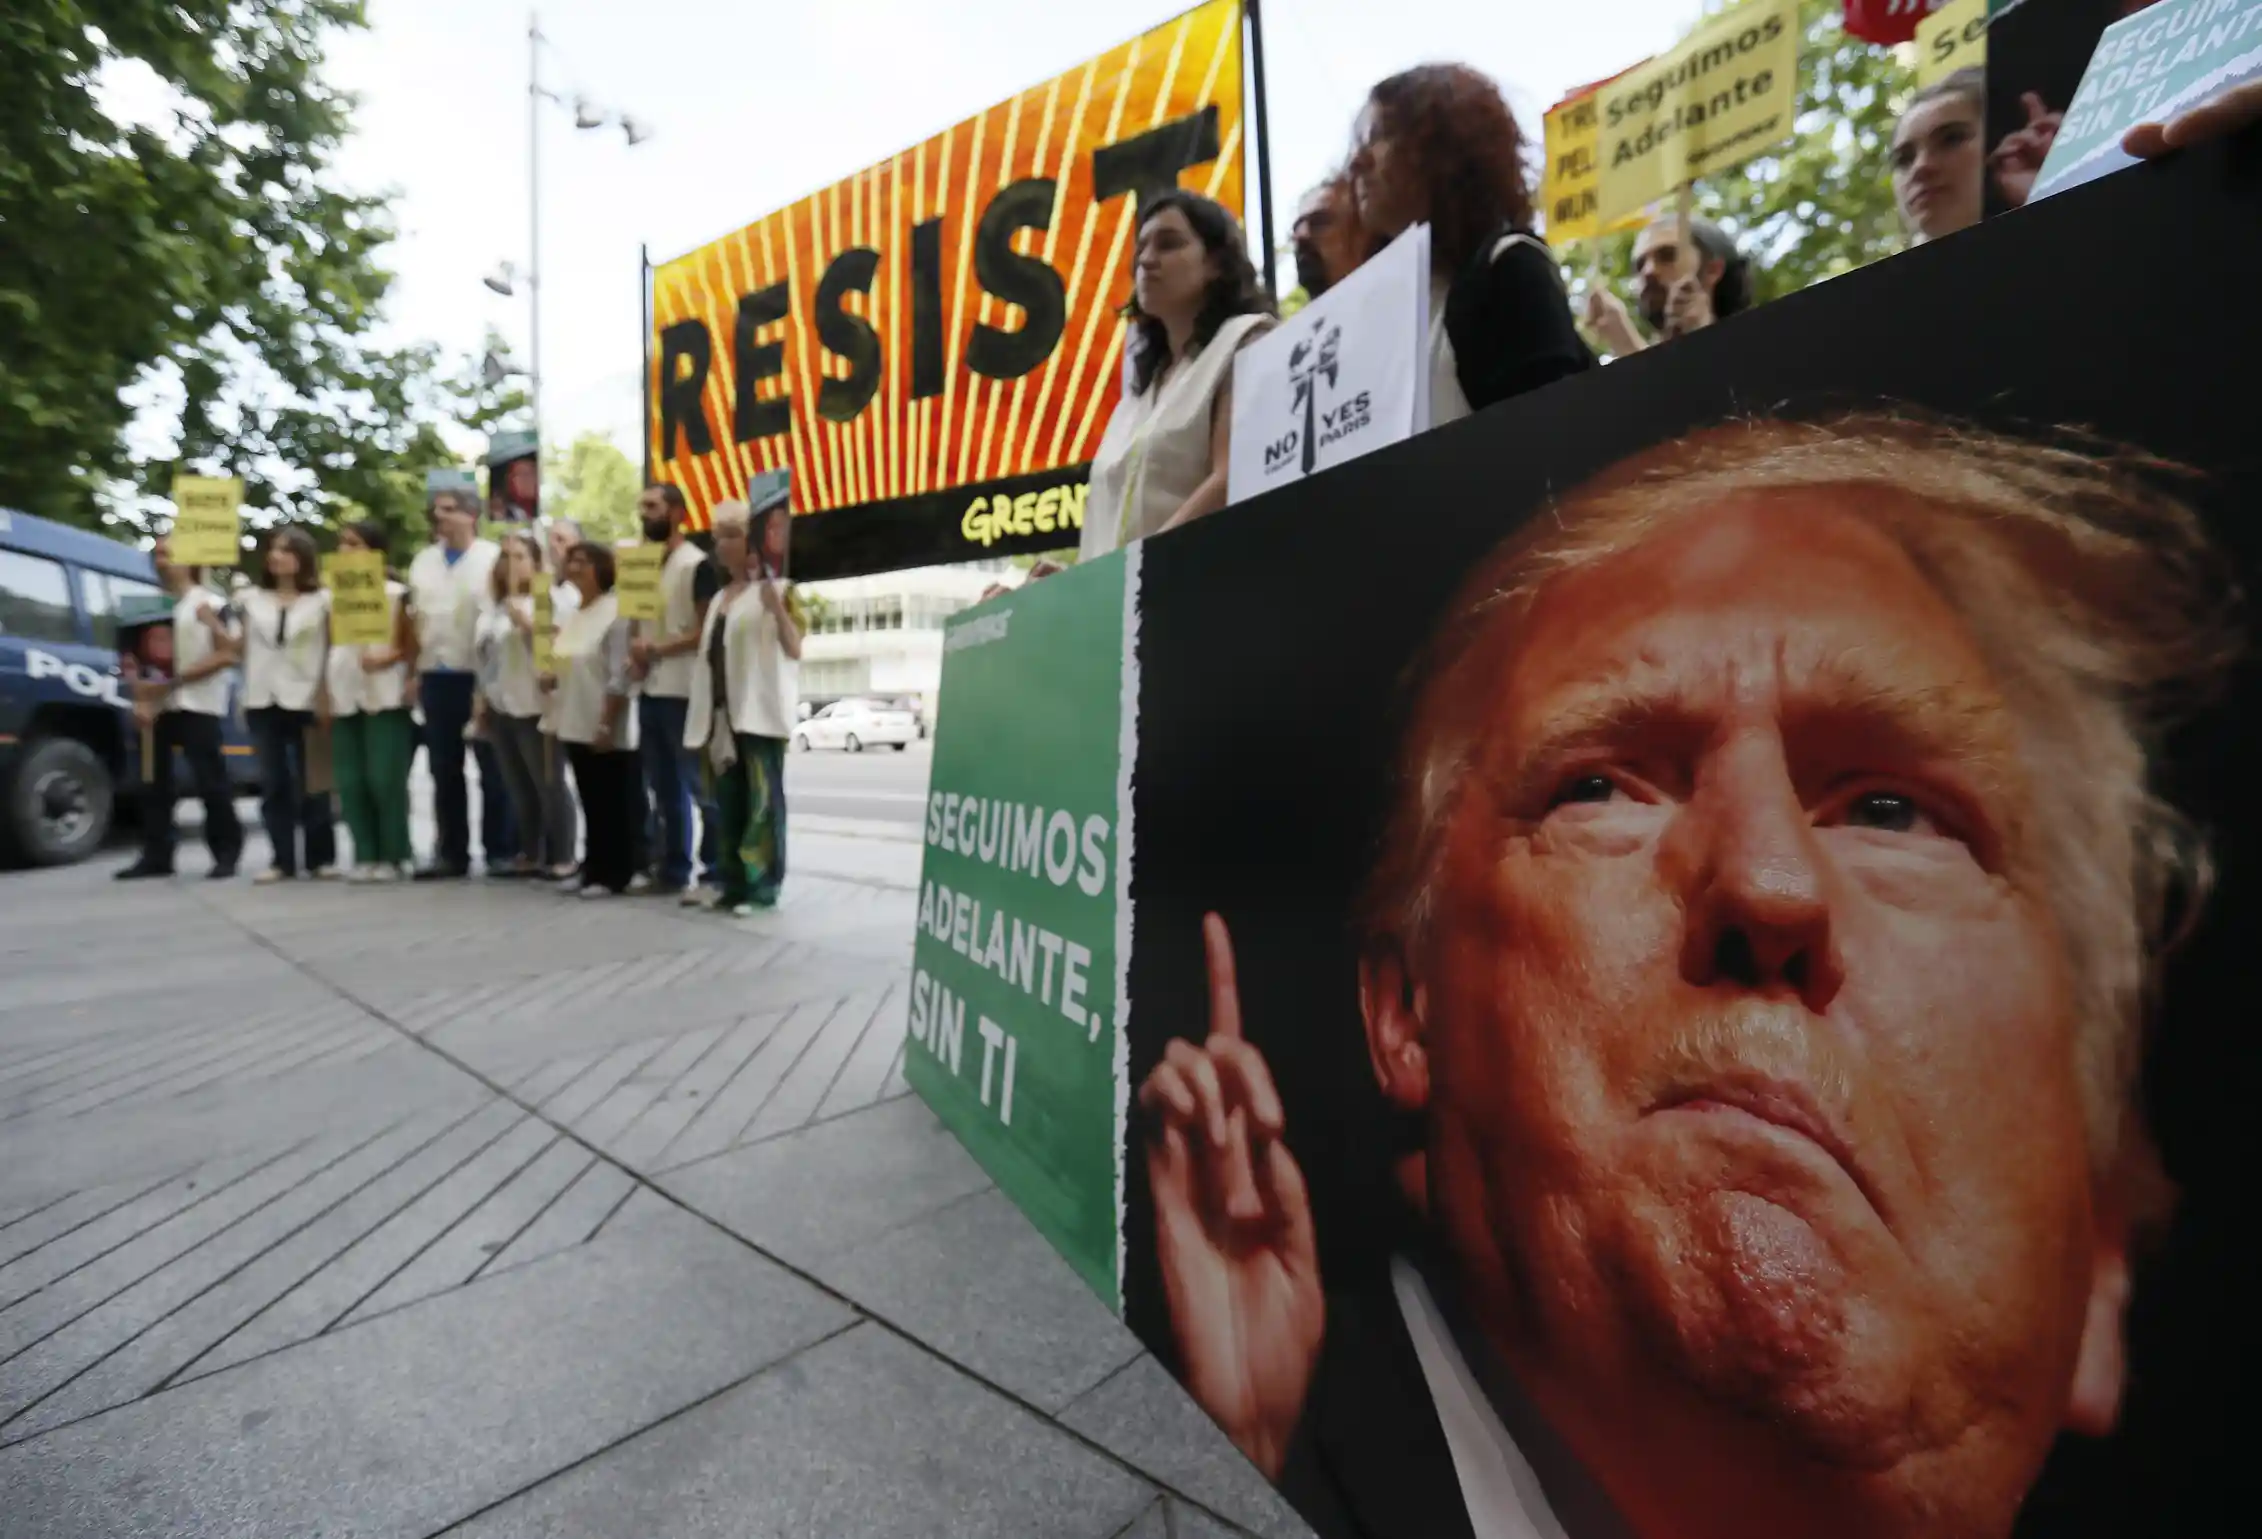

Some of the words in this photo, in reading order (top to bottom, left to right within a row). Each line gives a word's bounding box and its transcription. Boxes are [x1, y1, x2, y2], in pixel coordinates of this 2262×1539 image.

[1605, 14, 1783, 129] Seguimos
[2057, 98, 2121, 147] SIN
[2129, 79, 2168, 119] TI
[1611, 69, 1774, 170] Adelante
[660, 103, 1220, 463] RESIST
[1264, 430, 1297, 465] NO
[1320, 411, 1370, 447] PARIS
[1322, 391, 1371, 428] YES
[961, 482, 1091, 547] GREEN
[25, 648, 133, 709] POL
[927, 791, 1110, 897] SEGUIMOS
[918, 879, 1101, 1043] ADELANTE,
[910, 969, 966, 1077] SIN
[978, 1014, 1017, 1127] TI
